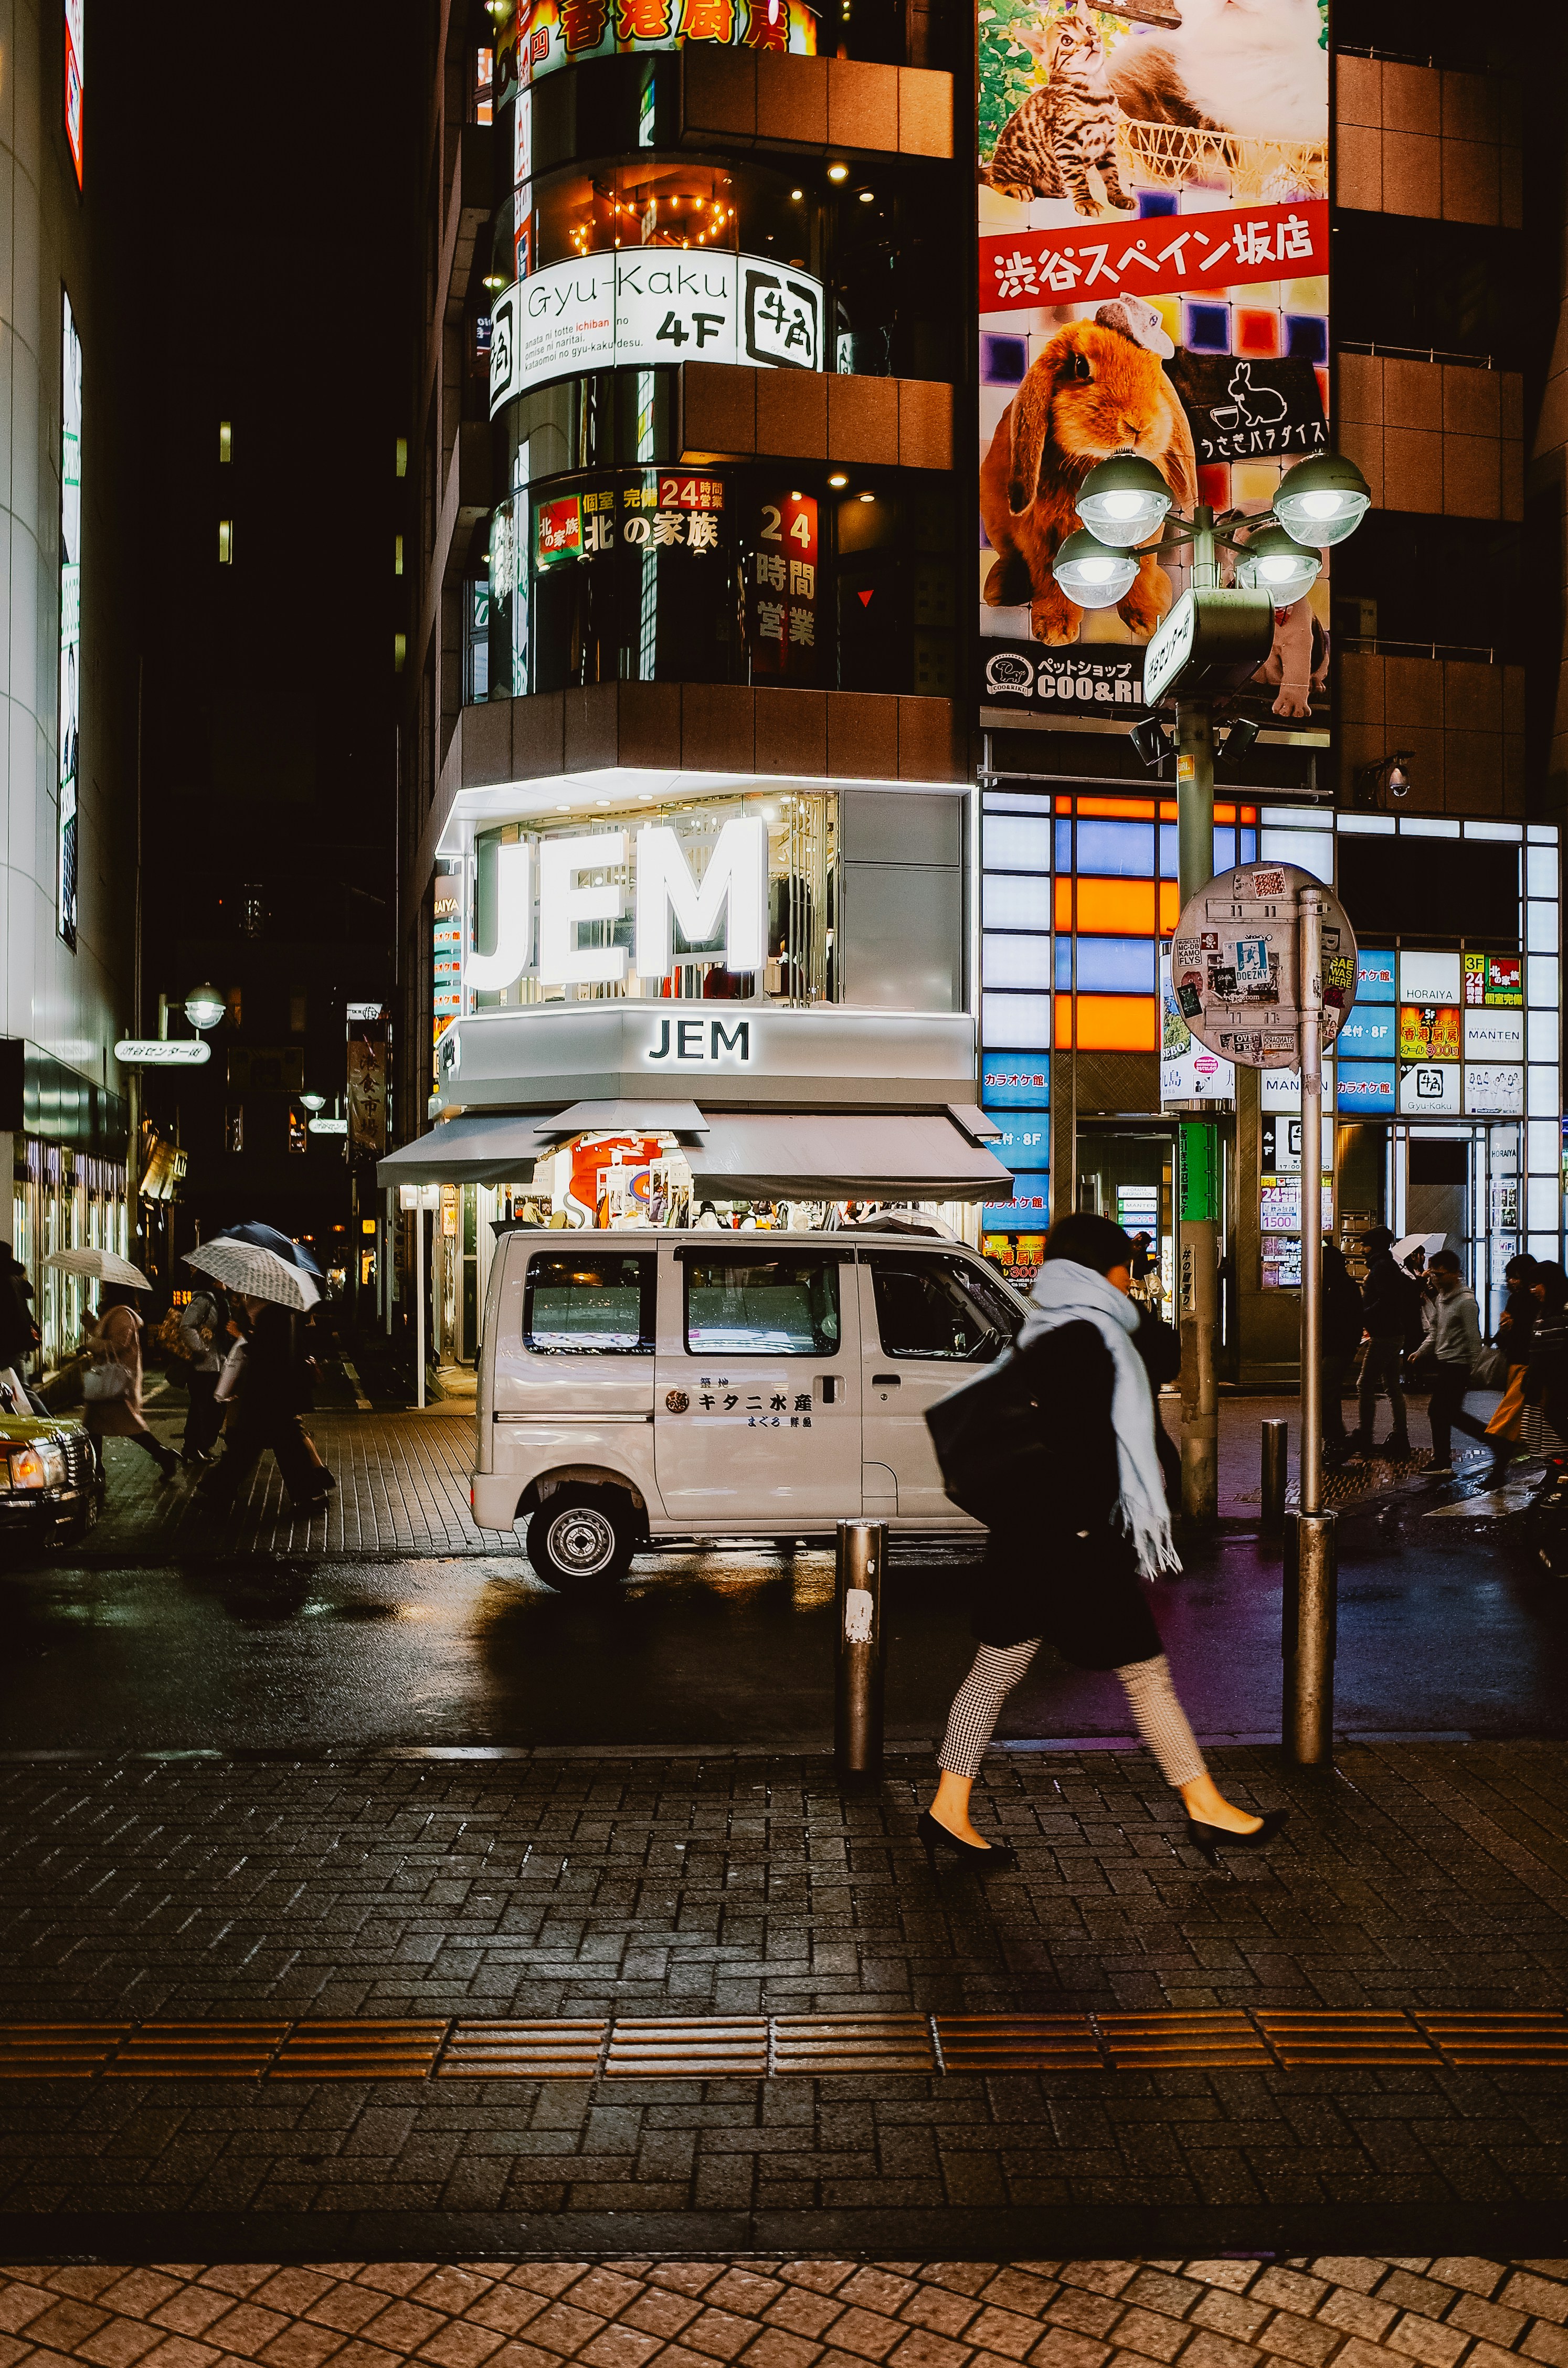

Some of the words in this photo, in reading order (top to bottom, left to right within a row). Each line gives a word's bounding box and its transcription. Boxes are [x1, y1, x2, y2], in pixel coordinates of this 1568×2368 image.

[557, 0, 789, 52] 香港厨房
[994, 214, 1313, 299] 渋谷スペイン坂店
[528, 265, 728, 317] Gyu-Kaku
[525, 335, 543, 350] anata
[545, 329, 552, 342] ni
[555, 325, 574, 337] totte
[576, 319, 609, 332] ichiban
[656, 311, 725, 348] 4F
[525, 346, 544, 361] omise
[546, 340, 554, 351] ni
[556, 333, 585, 348] naritai.
[525, 353, 557, 372] kataomoi
[559, 350, 569, 360] no
[572, 342, 613, 358] gyu-kaku
[617, 339, 643, 348] desu.
[1201, 422, 1325, 458] うさぎパラダイス
[662, 479, 699, 506] 24
[539, 517, 579, 547] 北の家族
[584, 510, 719, 552] 北の家族
[761, 505, 811, 548] 24
[757, 553, 814, 599] 時間
[757, 601, 814, 647] 営業
[1038, 658, 1132, 678] ペットショップ
[1038, 675, 1146, 704] COO&RI
[464, 816, 768, 992] JEM
[1180, 956, 1201, 965] FLYS
[1332, 957, 1354, 970] SAE
[1466, 957, 1484, 970] 3F
[1237, 970, 1267, 981] DOEZNY
[1328, 975, 1352, 988] HERE
[1331, 967, 1352, 979] WAS
[1466, 973, 1484, 987] 24
[1489, 966, 1520, 986] 北の家族
[1407, 990, 1453, 1000] HORAIYA
[1485, 993, 1522, 1005] 個室完備
[1425, 1009, 1435, 1019] 5F
[649, 1020, 750, 1061] JEM
[1403, 1026, 1458, 1043] 香港厨房
[1469, 1031, 1519, 1040] MANTEN
[984, 1073, 1045, 1087] カラオケ館
[1266, 1081, 1328, 1091] MANN
[1337, 1081, 1391, 1095] カラオケ館
[1407, 1102, 1453, 1113] Gyu-Kaku
[1491, 1149, 1517, 1158] HORAIYA
[1262, 1188, 1281, 1202] 24
[984, 1240, 993, 1249] 5F
[700, 1377, 729, 1388] 築地
[698, 1393, 812, 1412] キタニ水産
[747, 1415, 781, 1428] まぐろ
[790, 1416, 812, 1428] 鮮魚
